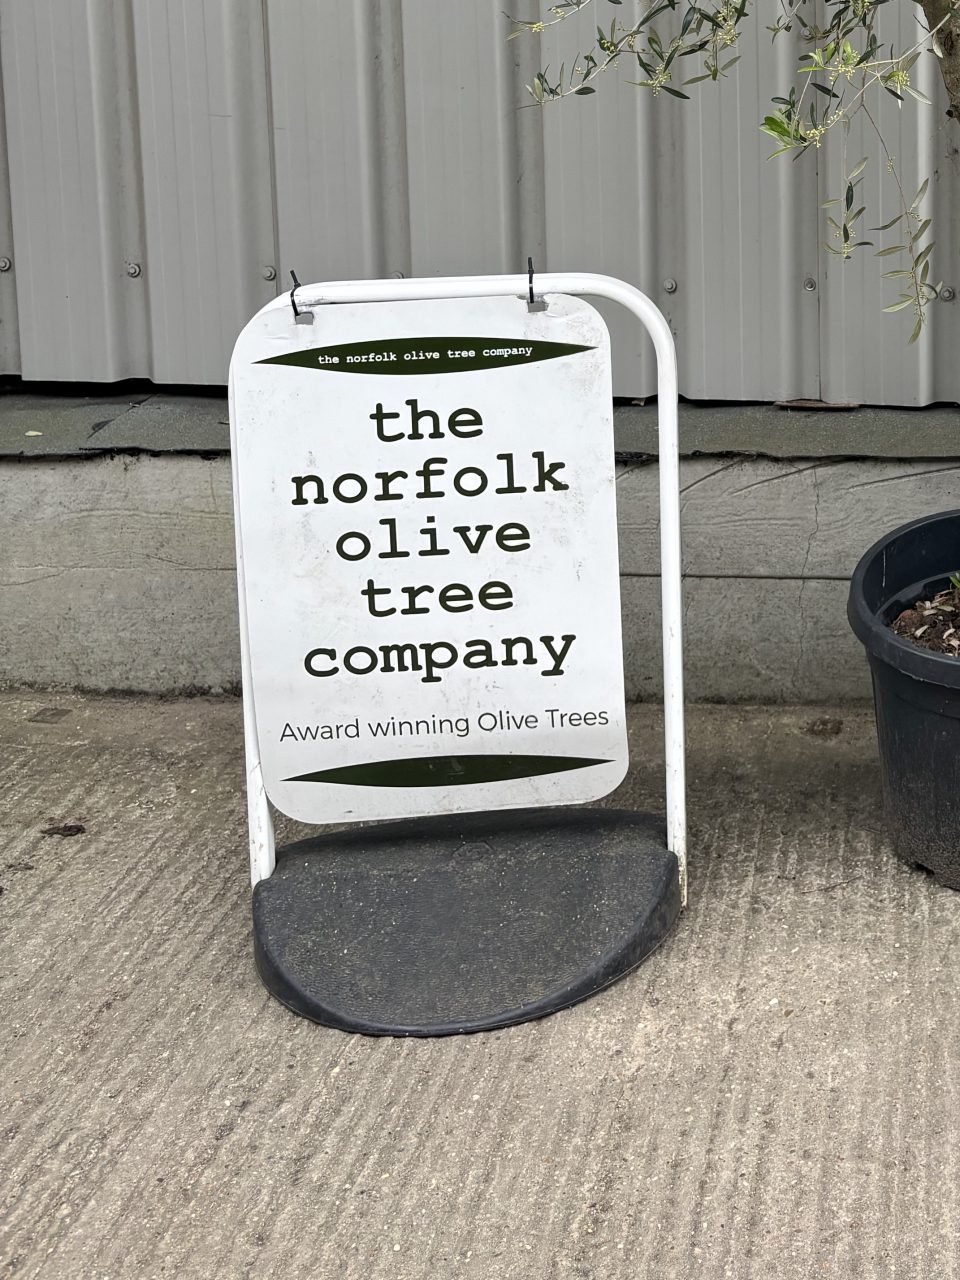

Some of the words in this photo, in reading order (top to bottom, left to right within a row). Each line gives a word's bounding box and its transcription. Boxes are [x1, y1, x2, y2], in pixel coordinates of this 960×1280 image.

[318, 354, 340, 364] the
[346, 352, 397, 363] norfolk
[403, 350, 440, 360] olive
[447, 349, 476, 358] tree
[482, 347, 533, 358] company
[369, 399, 484, 443] the
[291, 451, 570, 506] norfolk
[335, 515, 531, 562] olive
[360, 578, 514, 618] tree
[304, 634, 577, 683] company
[279, 718, 360, 742] Award
[367, 716, 470, 738] winning
[477, 710, 539, 732] Olive
[544, 708, 609, 728] Trees
